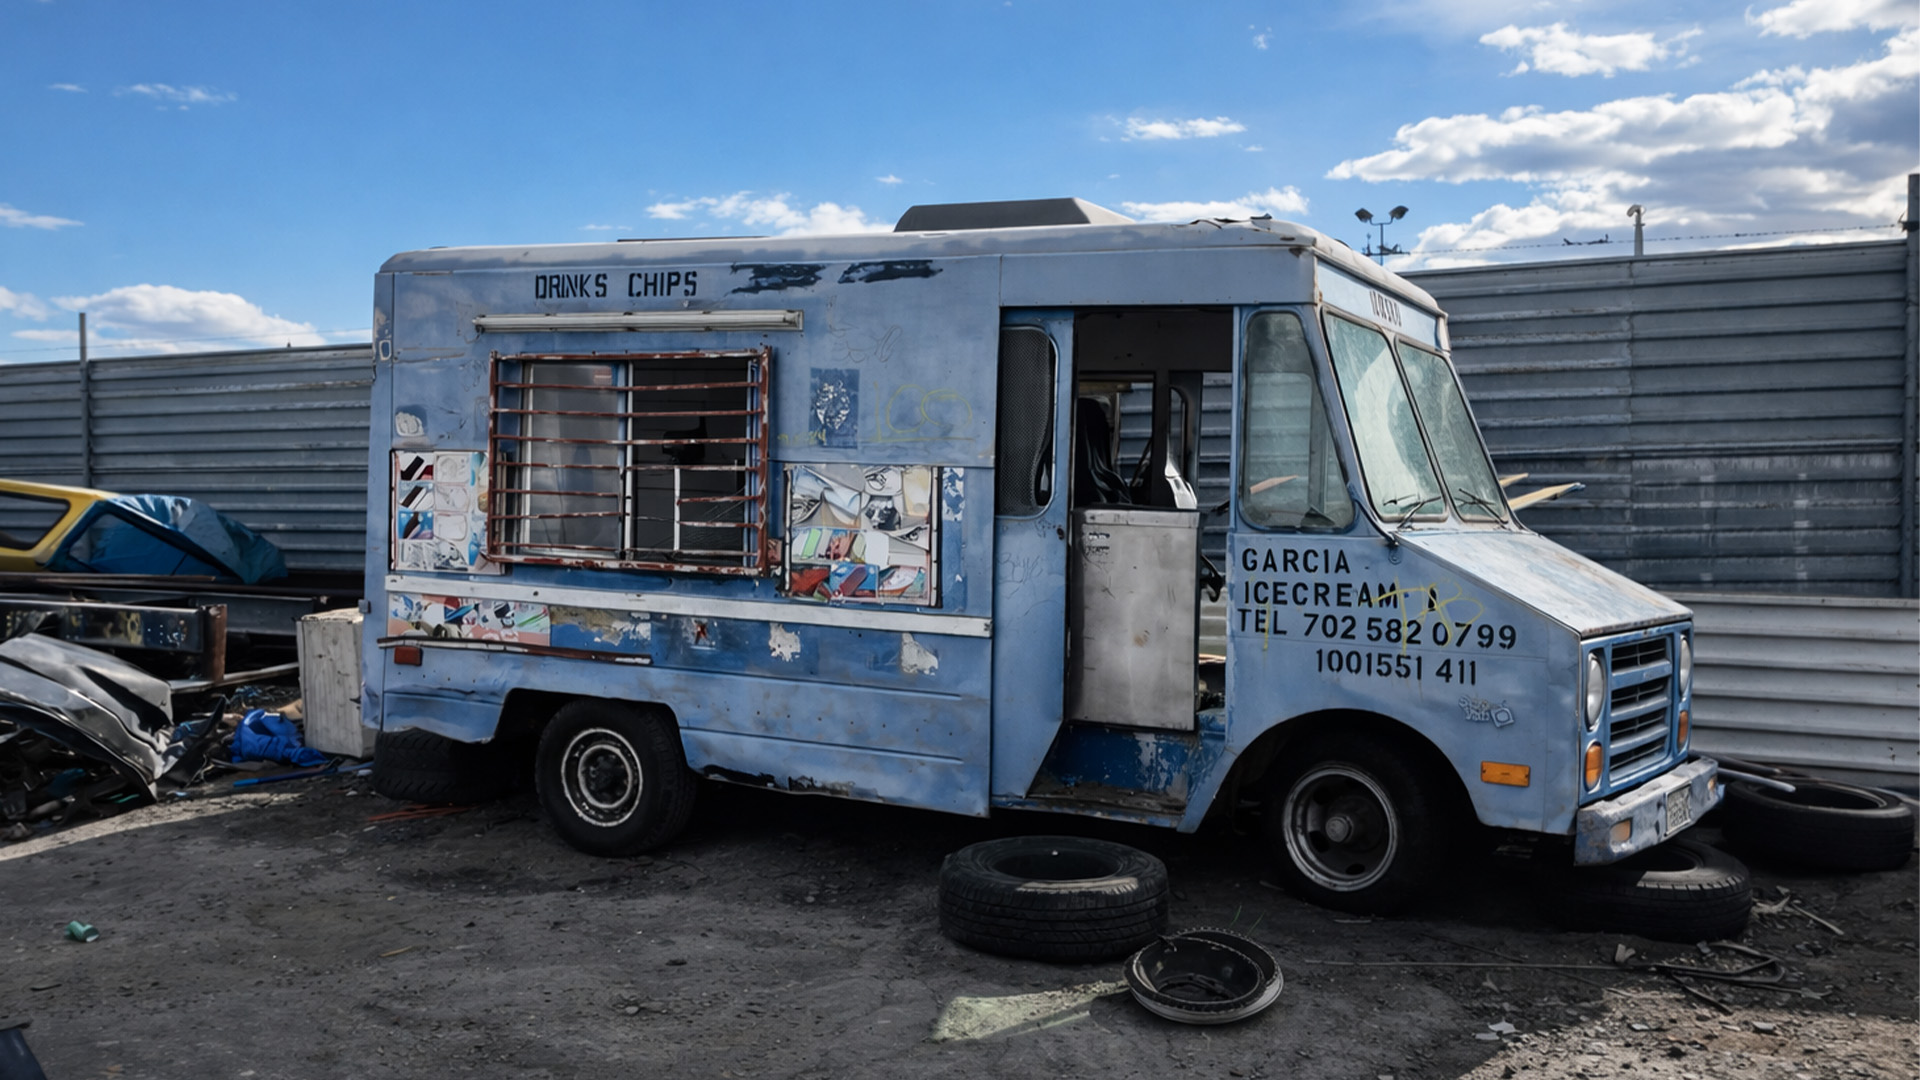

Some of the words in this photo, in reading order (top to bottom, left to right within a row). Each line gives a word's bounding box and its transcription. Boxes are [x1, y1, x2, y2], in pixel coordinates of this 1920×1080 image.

[535, 273, 608, 300] DRINKS
[628, 271, 698, 298] CHIPS
[1242, 547, 1351, 575] GARCIA
[1244, 580, 1399, 610] ICECREAM
[1237, 608, 1288, 636] TEL
[1303, 612, 1357, 641] 702
[1366, 616, 1422, 646] 582
[1432, 621, 1517, 650] 0799
[1316, 648, 1423, 681] 1001551
[1435, 657, 1477, 686] 411
